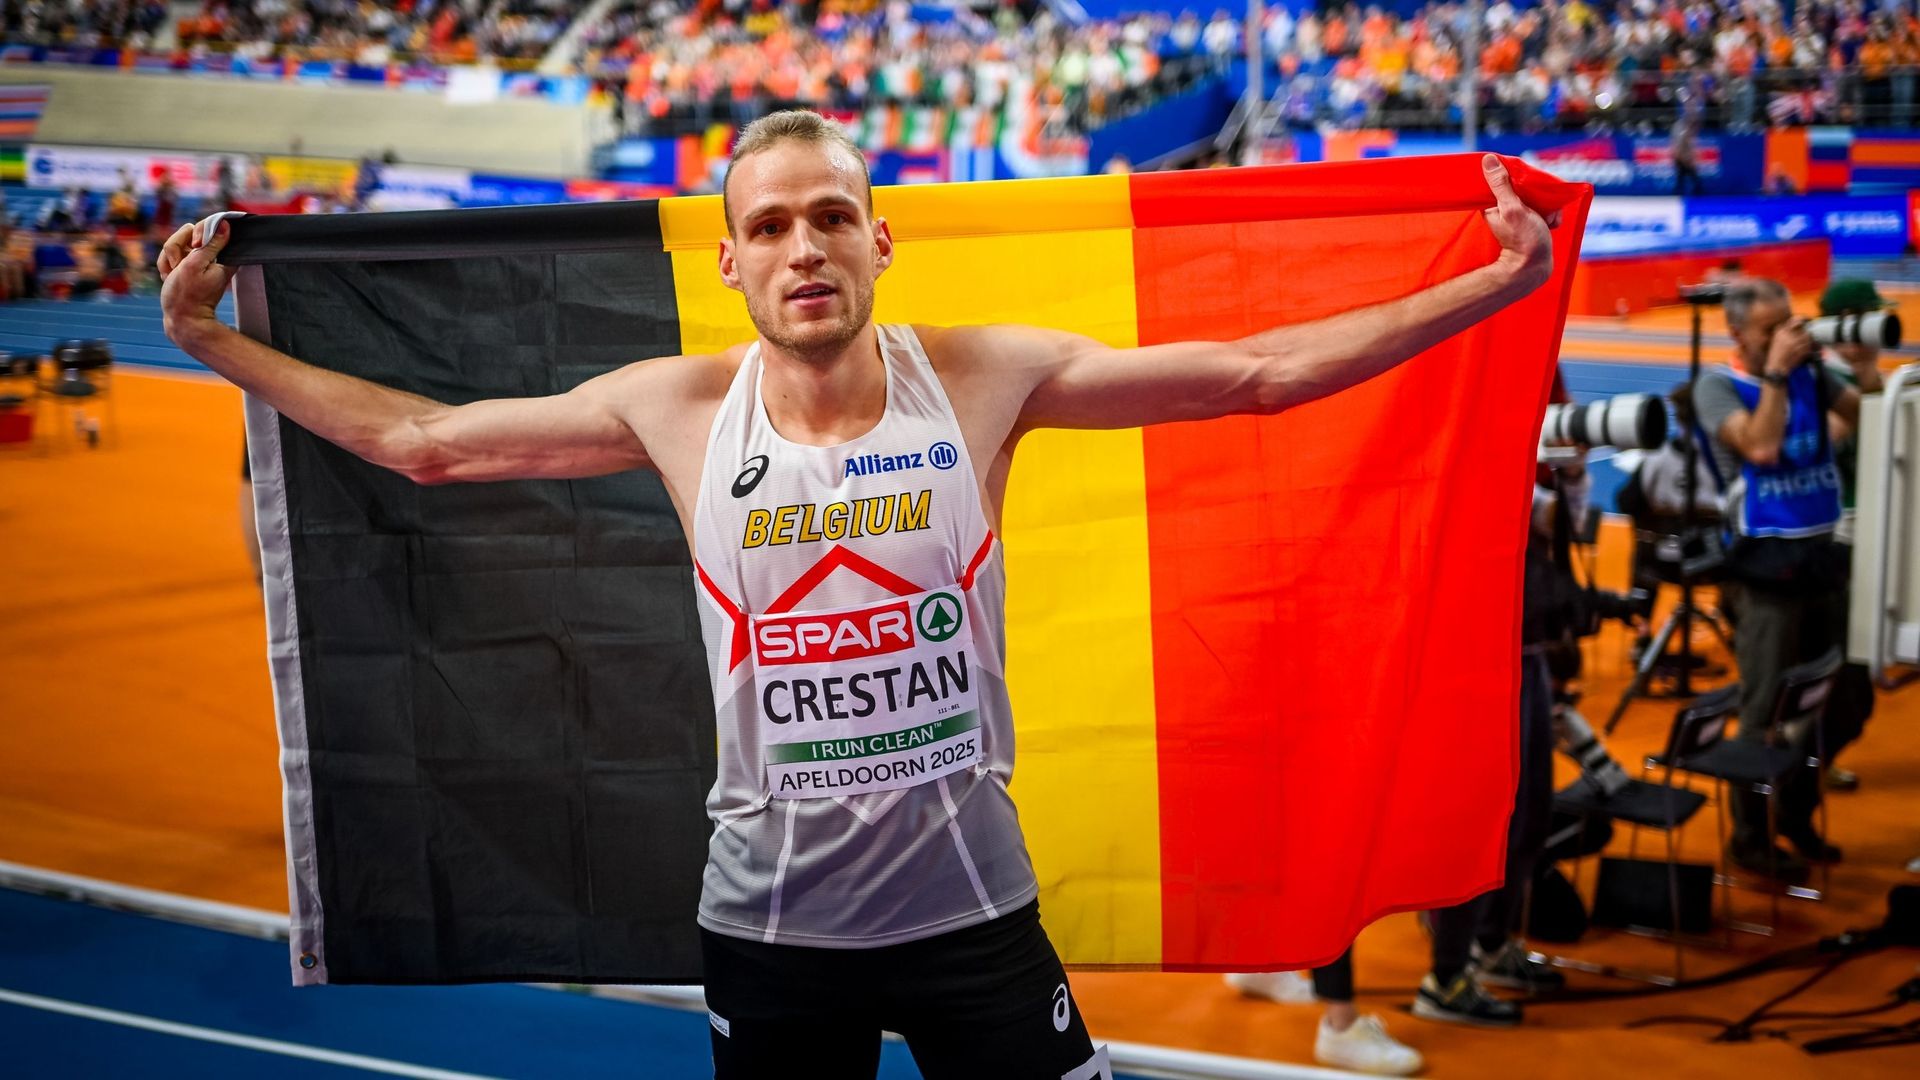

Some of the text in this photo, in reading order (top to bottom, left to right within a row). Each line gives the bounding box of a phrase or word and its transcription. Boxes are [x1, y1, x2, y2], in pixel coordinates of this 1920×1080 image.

[845, 452, 924, 478] Allianz
[742, 489, 932, 549] BELGIUM
[759, 610, 909, 658] SPAR
[763, 651, 969, 724] CRESTAN
[780, 739, 976, 791] APELDOORN 2025
[812, 743, 817, 758] I
[821, 740, 865, 758] RUN
